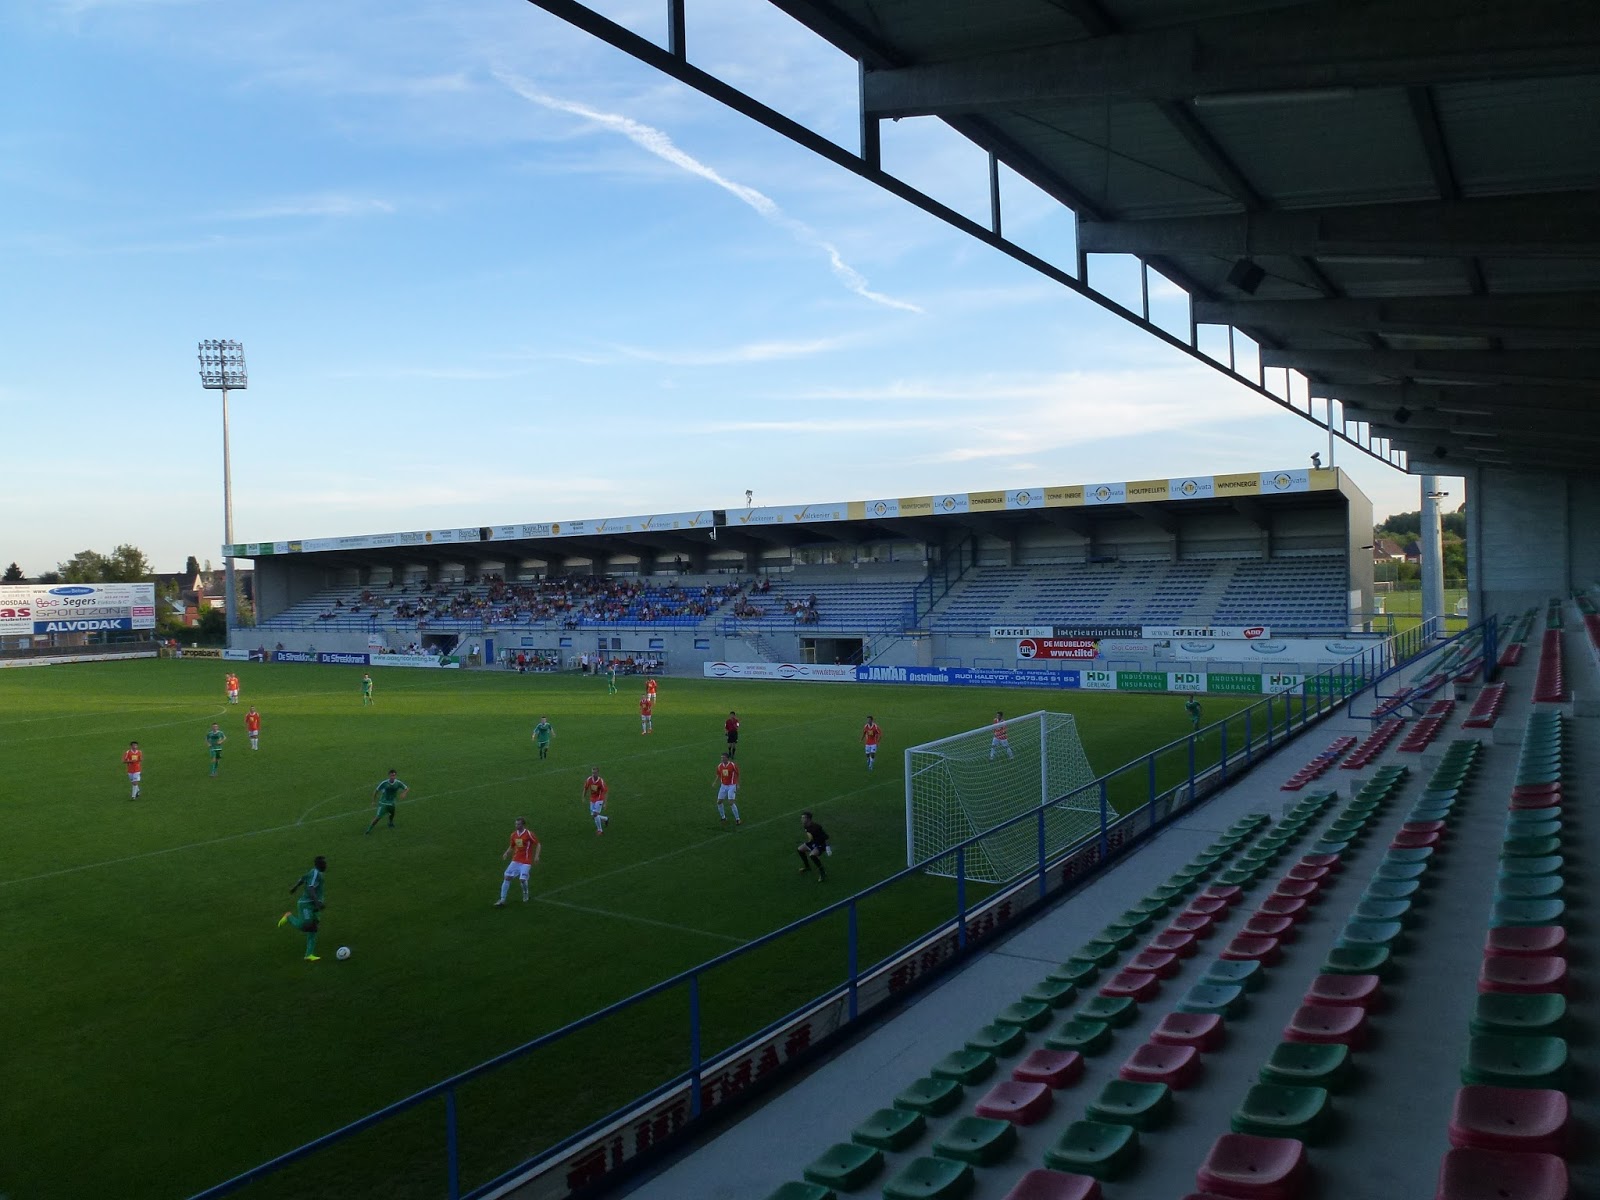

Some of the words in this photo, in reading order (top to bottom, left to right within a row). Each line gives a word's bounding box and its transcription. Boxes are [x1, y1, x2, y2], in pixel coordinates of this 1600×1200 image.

[1217, 480, 1257, 489] WINDENERGIE
[1128, 486, 1166, 495] HOUTPELLETS
[63, 598, 96, 608] Segers
[46, 619, 122, 632] ALVODAK
[1043, 640, 1053, 648] DE
[322, 654, 330, 662] De
[331, 654, 365, 664] Streekkrant
[868, 667, 907, 681] JAMAR
[909, 672, 949, 682] Distributie
[1086, 672, 1110, 682] HDI
[1174, 673, 1200, 683] HDI
[1121, 680, 1163, 688] INSURANCE
[1269, 675, 1297, 686] HDI
[1211, 683, 1256, 691] INSURANCE
